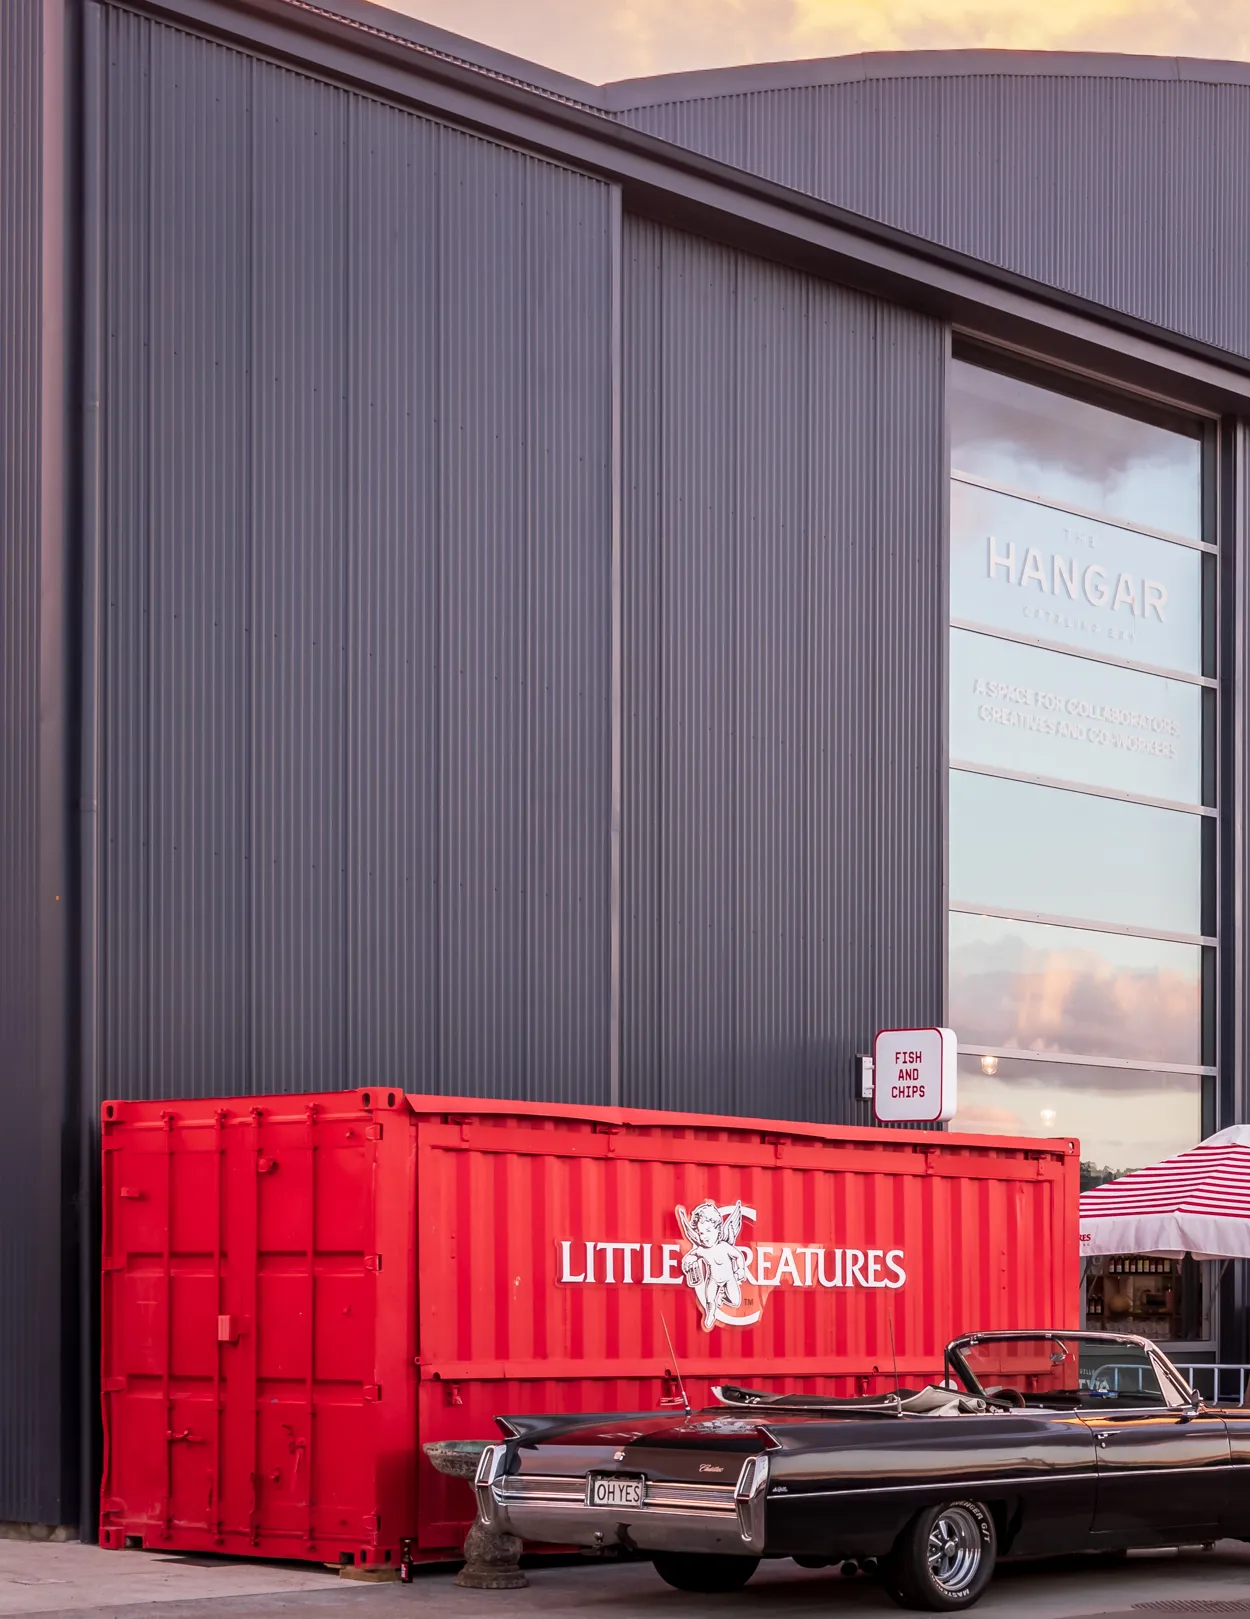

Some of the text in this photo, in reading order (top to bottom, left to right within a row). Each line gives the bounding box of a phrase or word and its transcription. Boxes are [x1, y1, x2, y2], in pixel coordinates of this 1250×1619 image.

[1063, 529, 1096, 549] THE
[987, 536, 1168, 623] HANGAR
[985, 681, 1034, 706] SPACE
[1035, 691, 1065, 712] FOR
[978, 704, 1178, 759] CREATIVES AND CO-WORKERS
[895, 1051, 922, 1064] FISH
[898, 1068, 919, 1081] AND
[891, 1085, 925, 1098] CHIPS
[561, 1241, 685, 1284] LITTLE
[950, 1500, 990, 1543] AVENGER G/T
